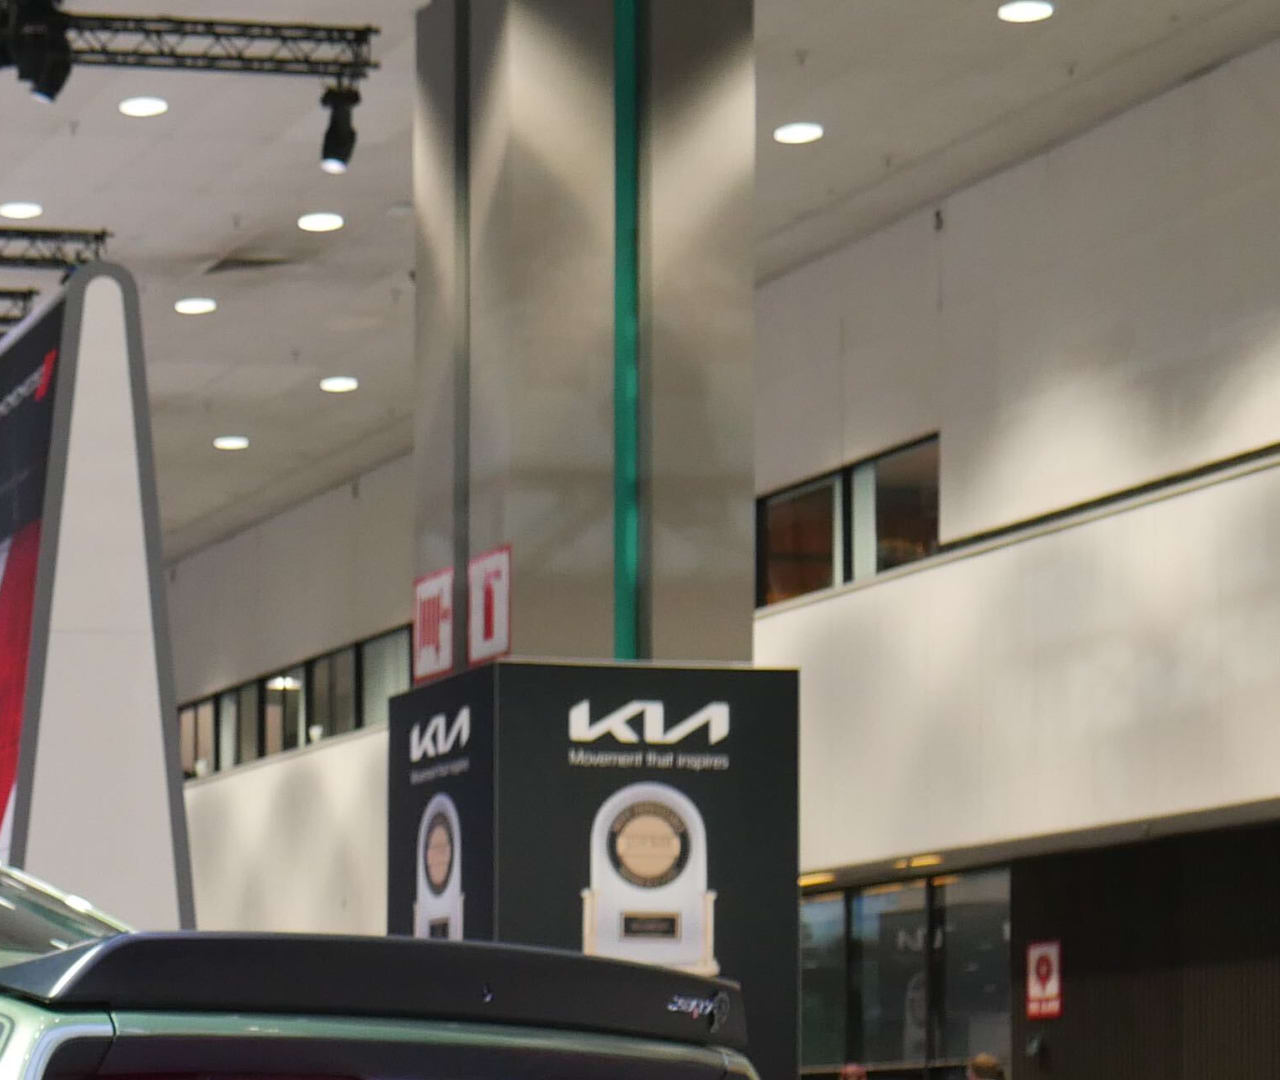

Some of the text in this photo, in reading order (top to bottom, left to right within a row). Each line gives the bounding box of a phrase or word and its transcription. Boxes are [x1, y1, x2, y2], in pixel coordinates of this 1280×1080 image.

[409, 705, 471, 763] KIA
[568, 699, 730, 746] KIA
[568, 748, 730, 772] Movement that inspires
